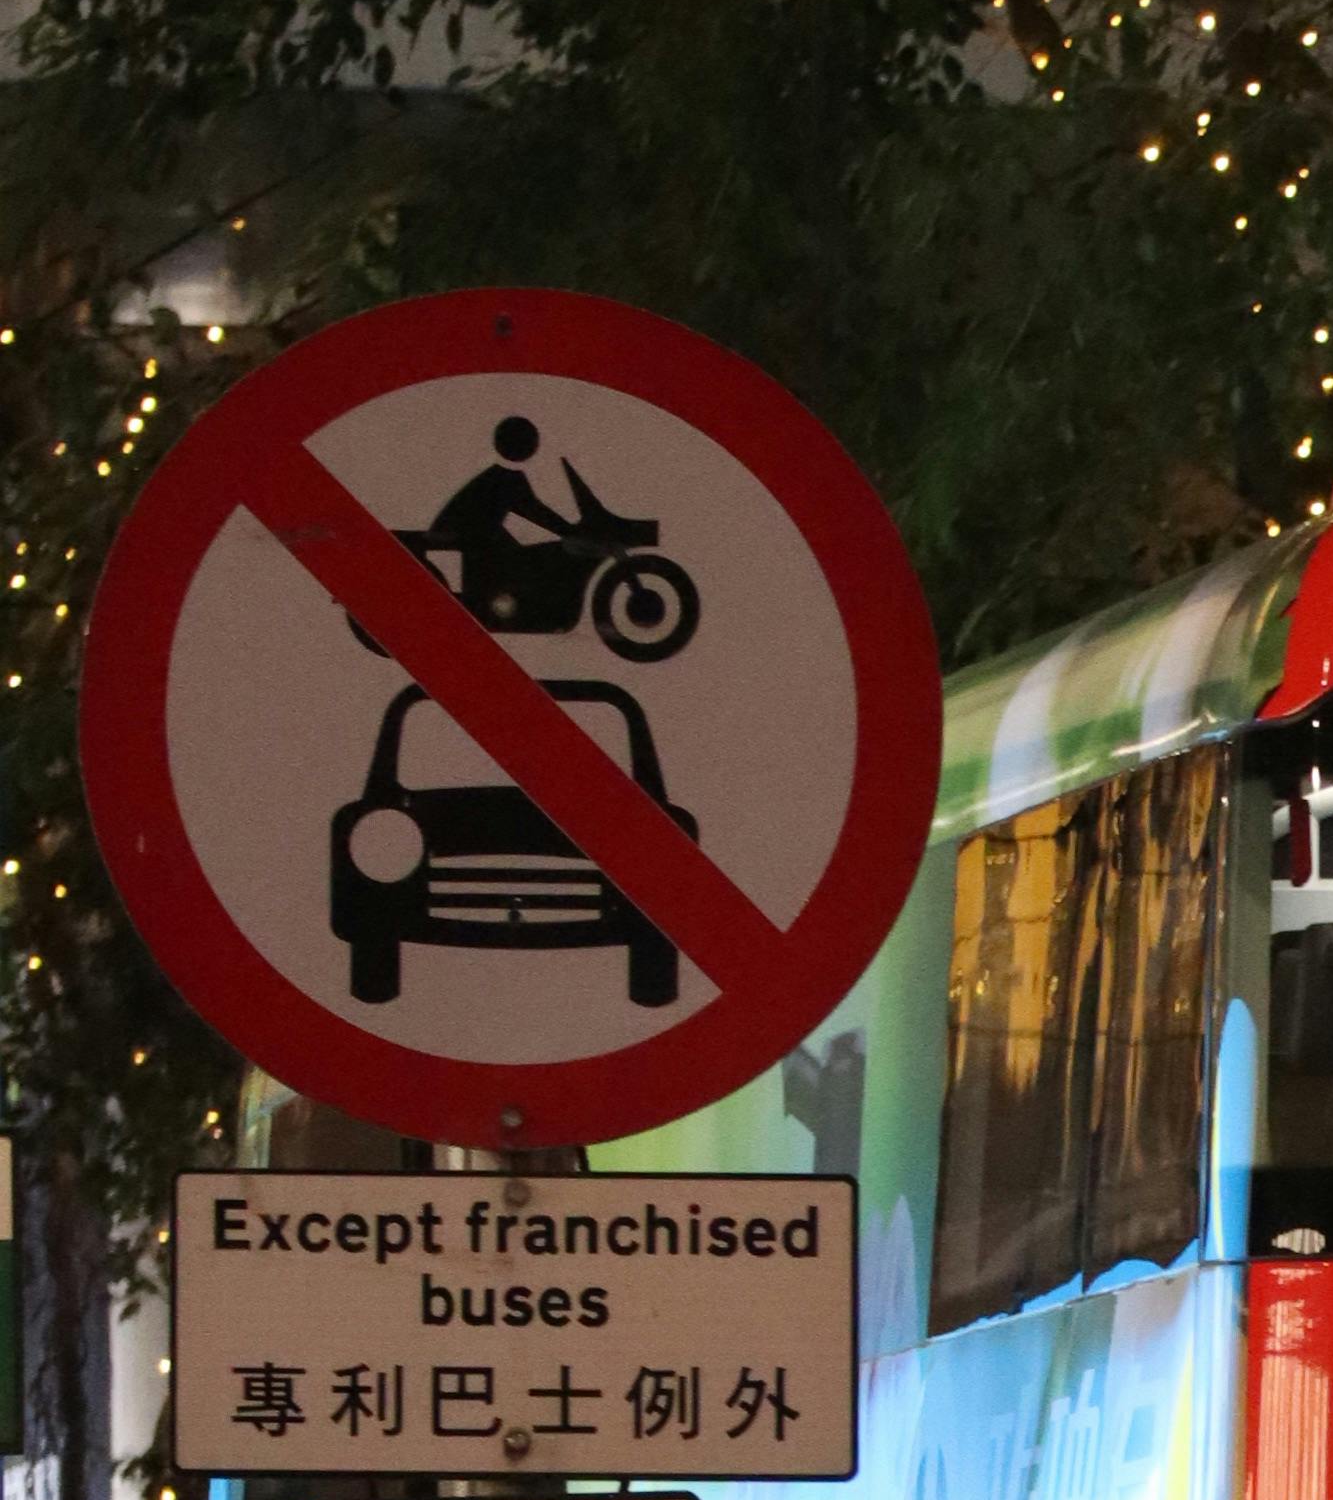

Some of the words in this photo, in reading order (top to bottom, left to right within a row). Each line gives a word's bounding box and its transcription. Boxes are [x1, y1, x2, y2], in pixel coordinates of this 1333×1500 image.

[213, 1198, 444, 1264] Except
[465, 1198, 819, 1259] franchised
[421, 1272, 610, 1328] buses
[230, 1361, 801, 1442] 專利巴士例外
